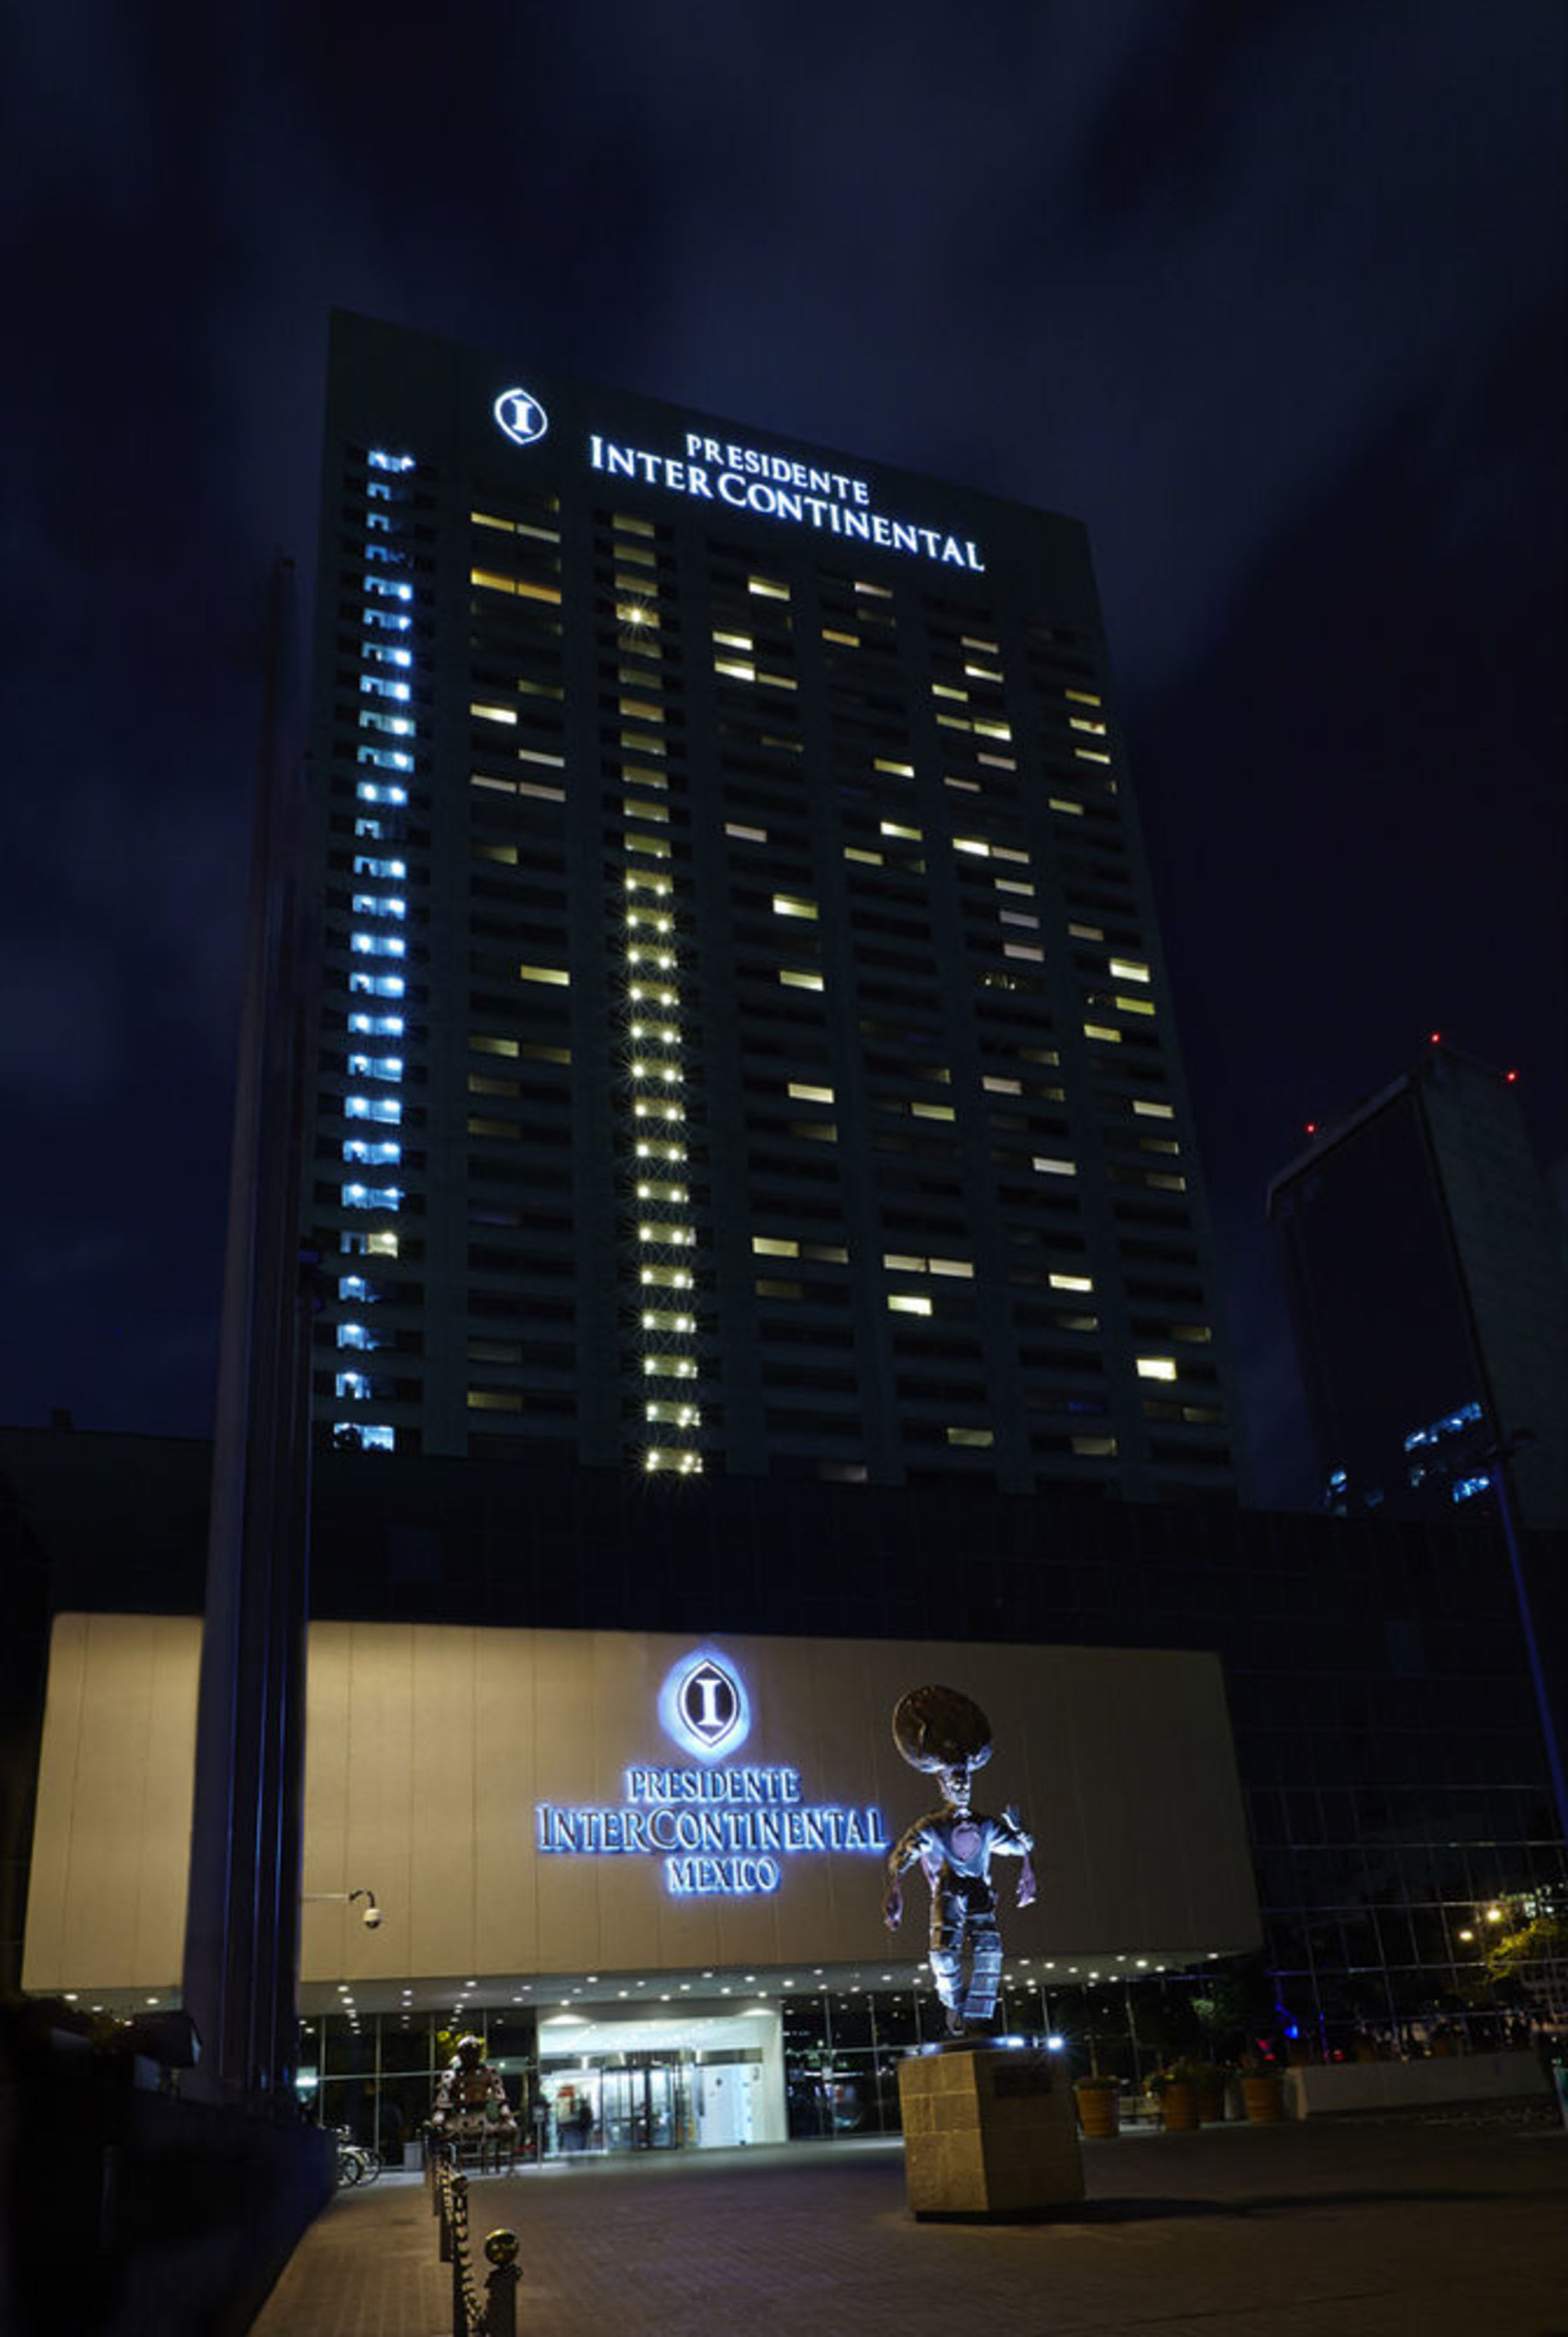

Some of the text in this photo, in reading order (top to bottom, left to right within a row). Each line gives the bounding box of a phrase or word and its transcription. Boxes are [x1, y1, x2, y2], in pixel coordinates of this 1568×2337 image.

[686, 433, 870, 505] PRESIDENTE
[625, 1767, 800, 1803] PRESIDENTE
[536, 1804, 889, 1852] INTERCONTINENTAL
[666, 1856, 779, 1893] MEXICO
